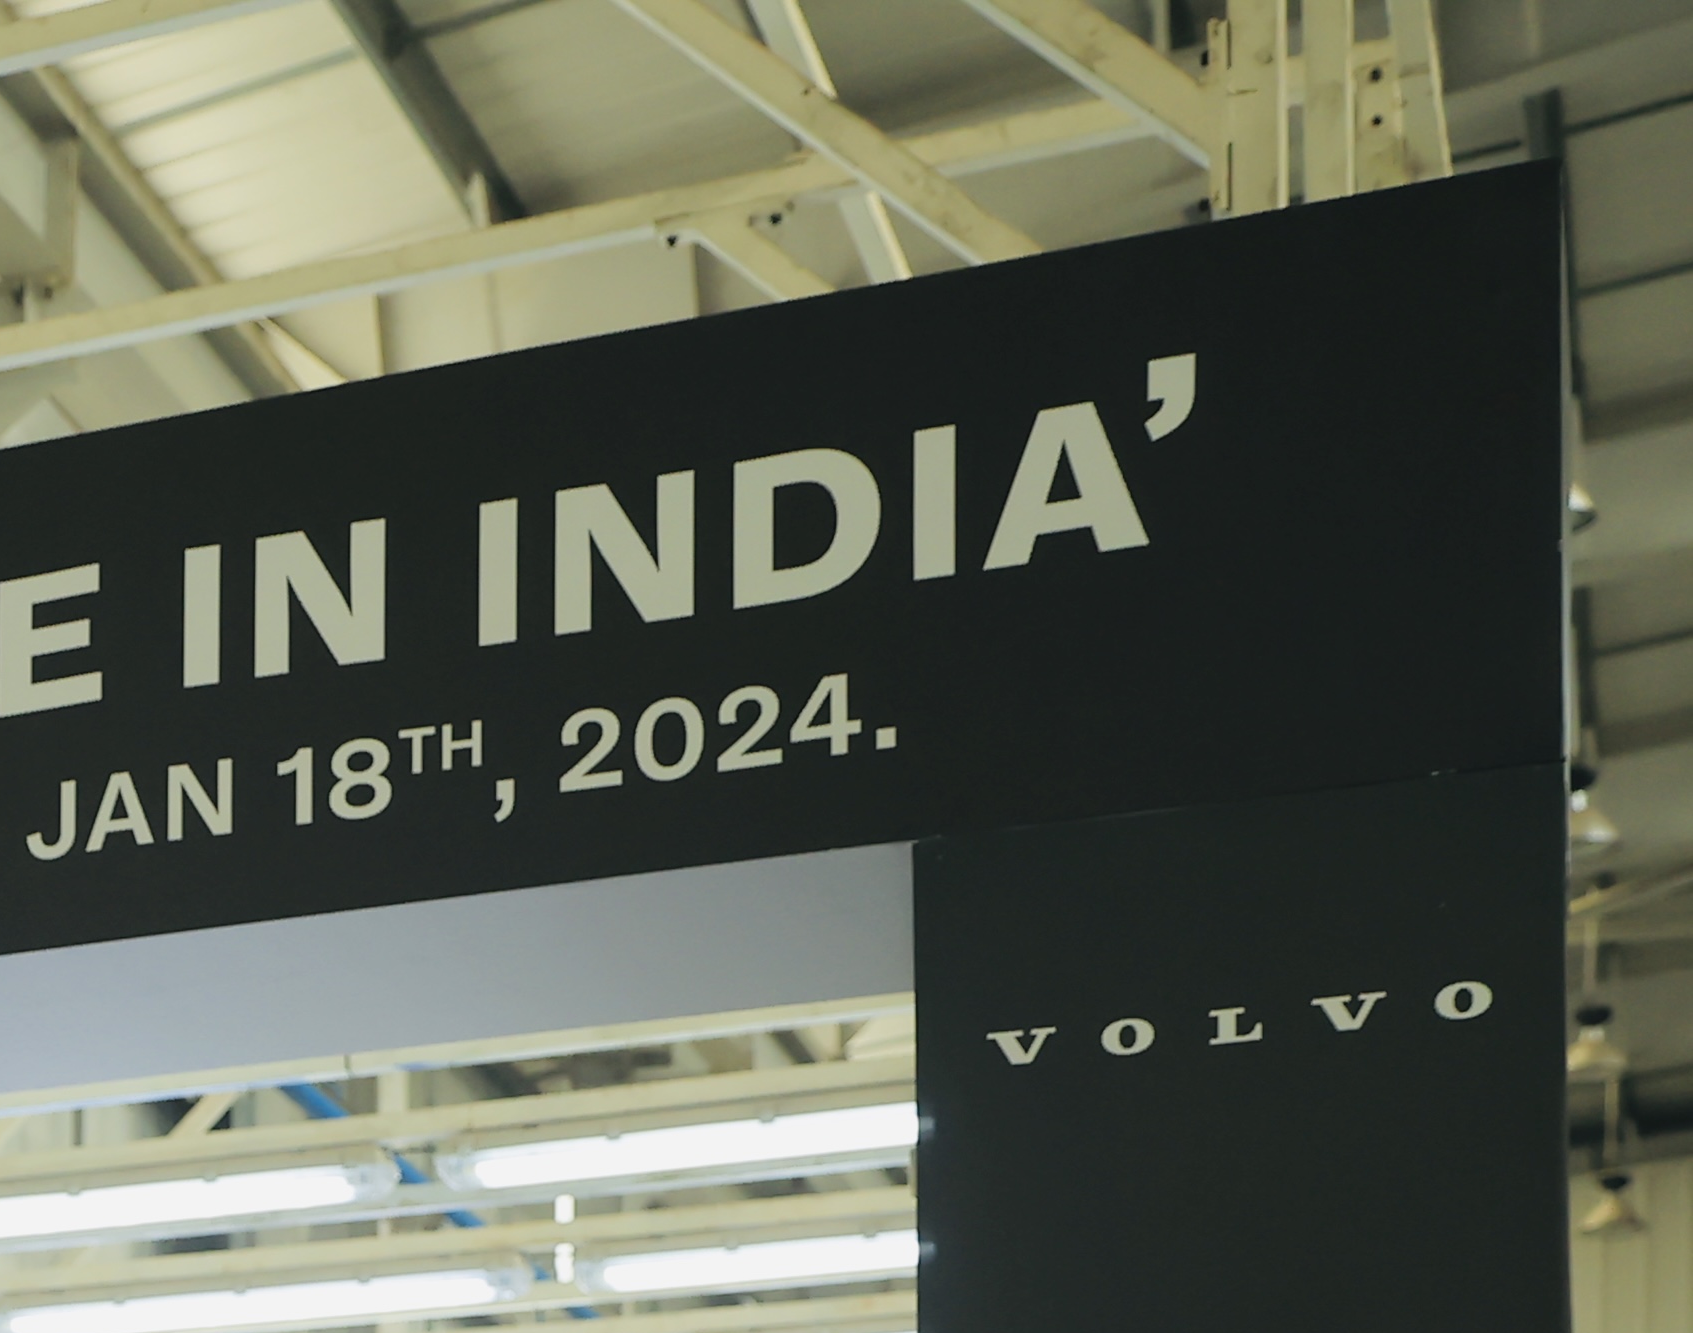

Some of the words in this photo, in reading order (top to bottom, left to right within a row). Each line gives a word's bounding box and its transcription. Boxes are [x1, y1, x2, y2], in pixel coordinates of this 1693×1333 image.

[183, 517, 387, 688] IN
[26, 757, 234, 861] JAN
[276, 719, 516, 826] 18TH,
[559, 673, 898, 793] 2024.
[986, 981, 1494, 1065] VOLVO
